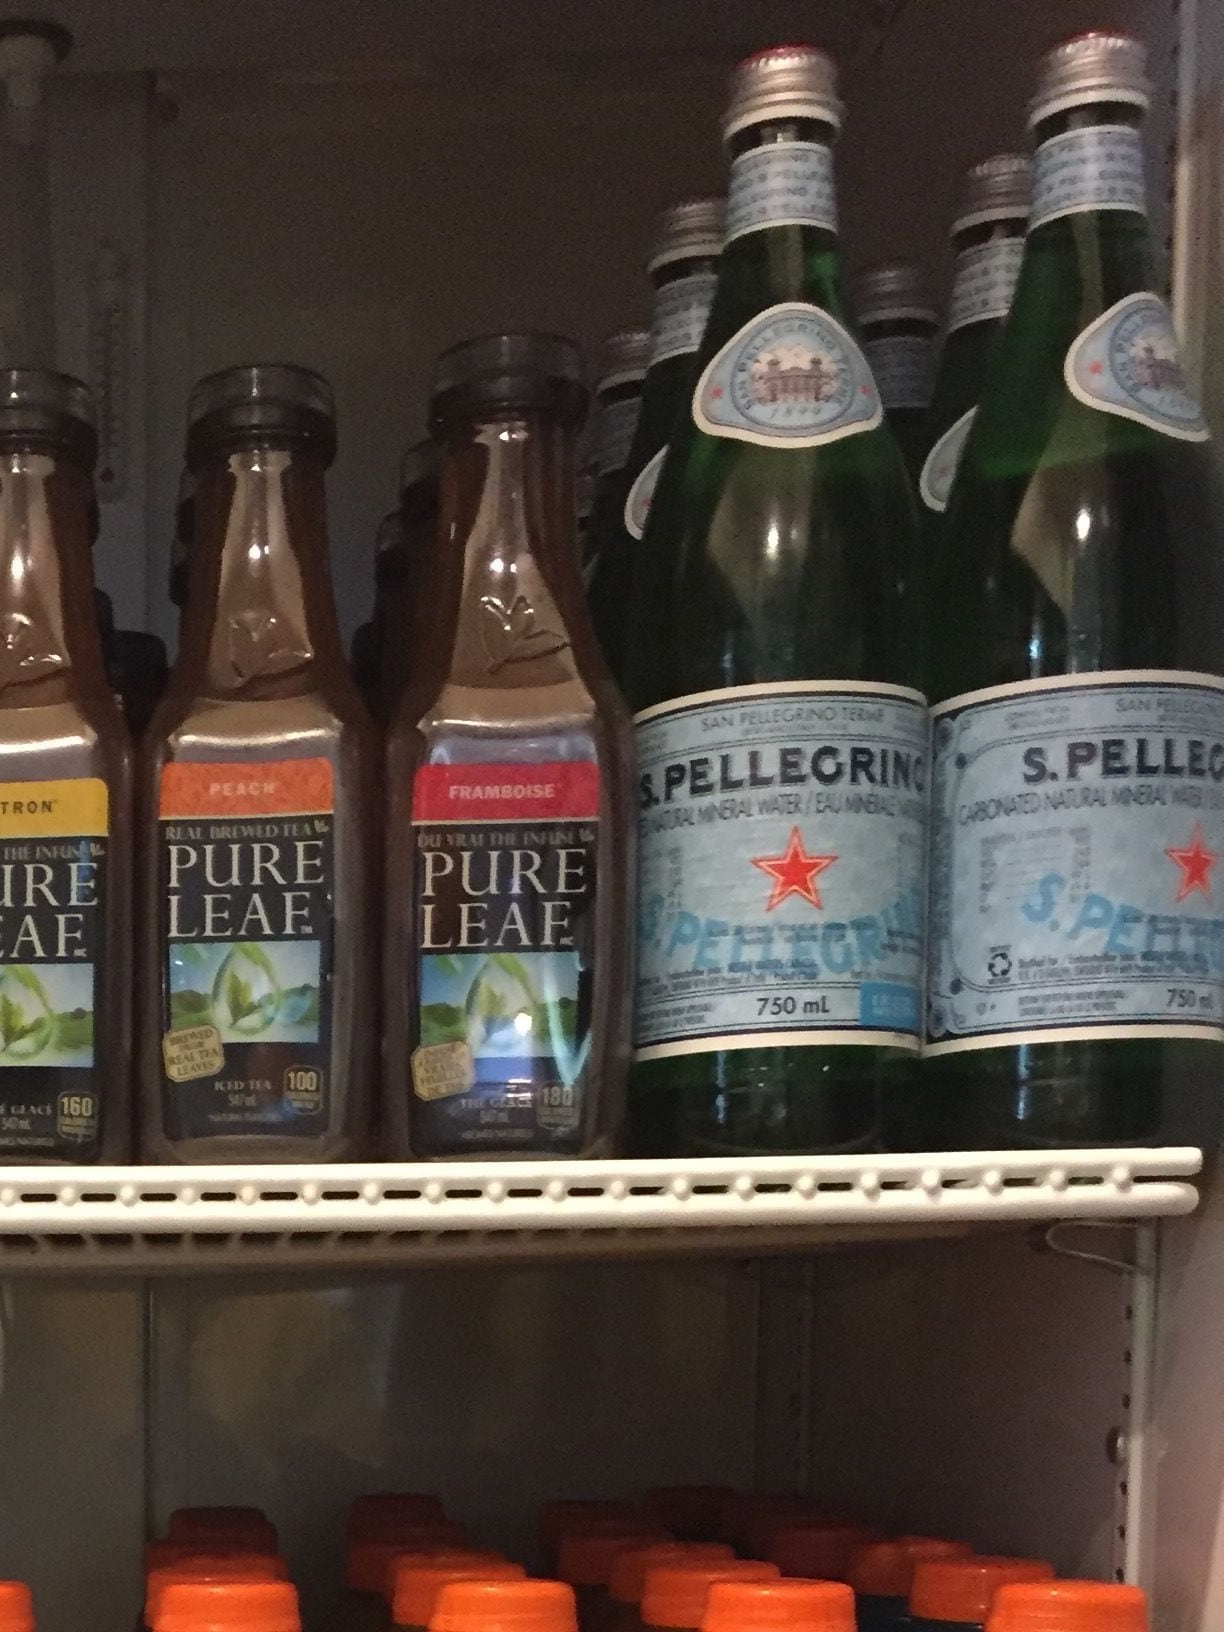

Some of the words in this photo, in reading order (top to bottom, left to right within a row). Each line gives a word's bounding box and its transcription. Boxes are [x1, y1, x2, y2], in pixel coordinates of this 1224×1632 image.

[209, 782, 276, 796] PEACH
[449, 783, 555, 799] FRAMBOISE
[168, 840, 324, 888] PURE
[421, 848, 587, 896] PURE
[167, 891, 311, 938] LEAF
[420, 901, 572, 948] LEAF
[756, 996, 797, 1016] 750
[803, 996, 829, 1014] mL
[1167, 987, 1195, 1007] 750
[288, 1071, 317, 1091] 100
[61, 1096, 93, 1116] 160
